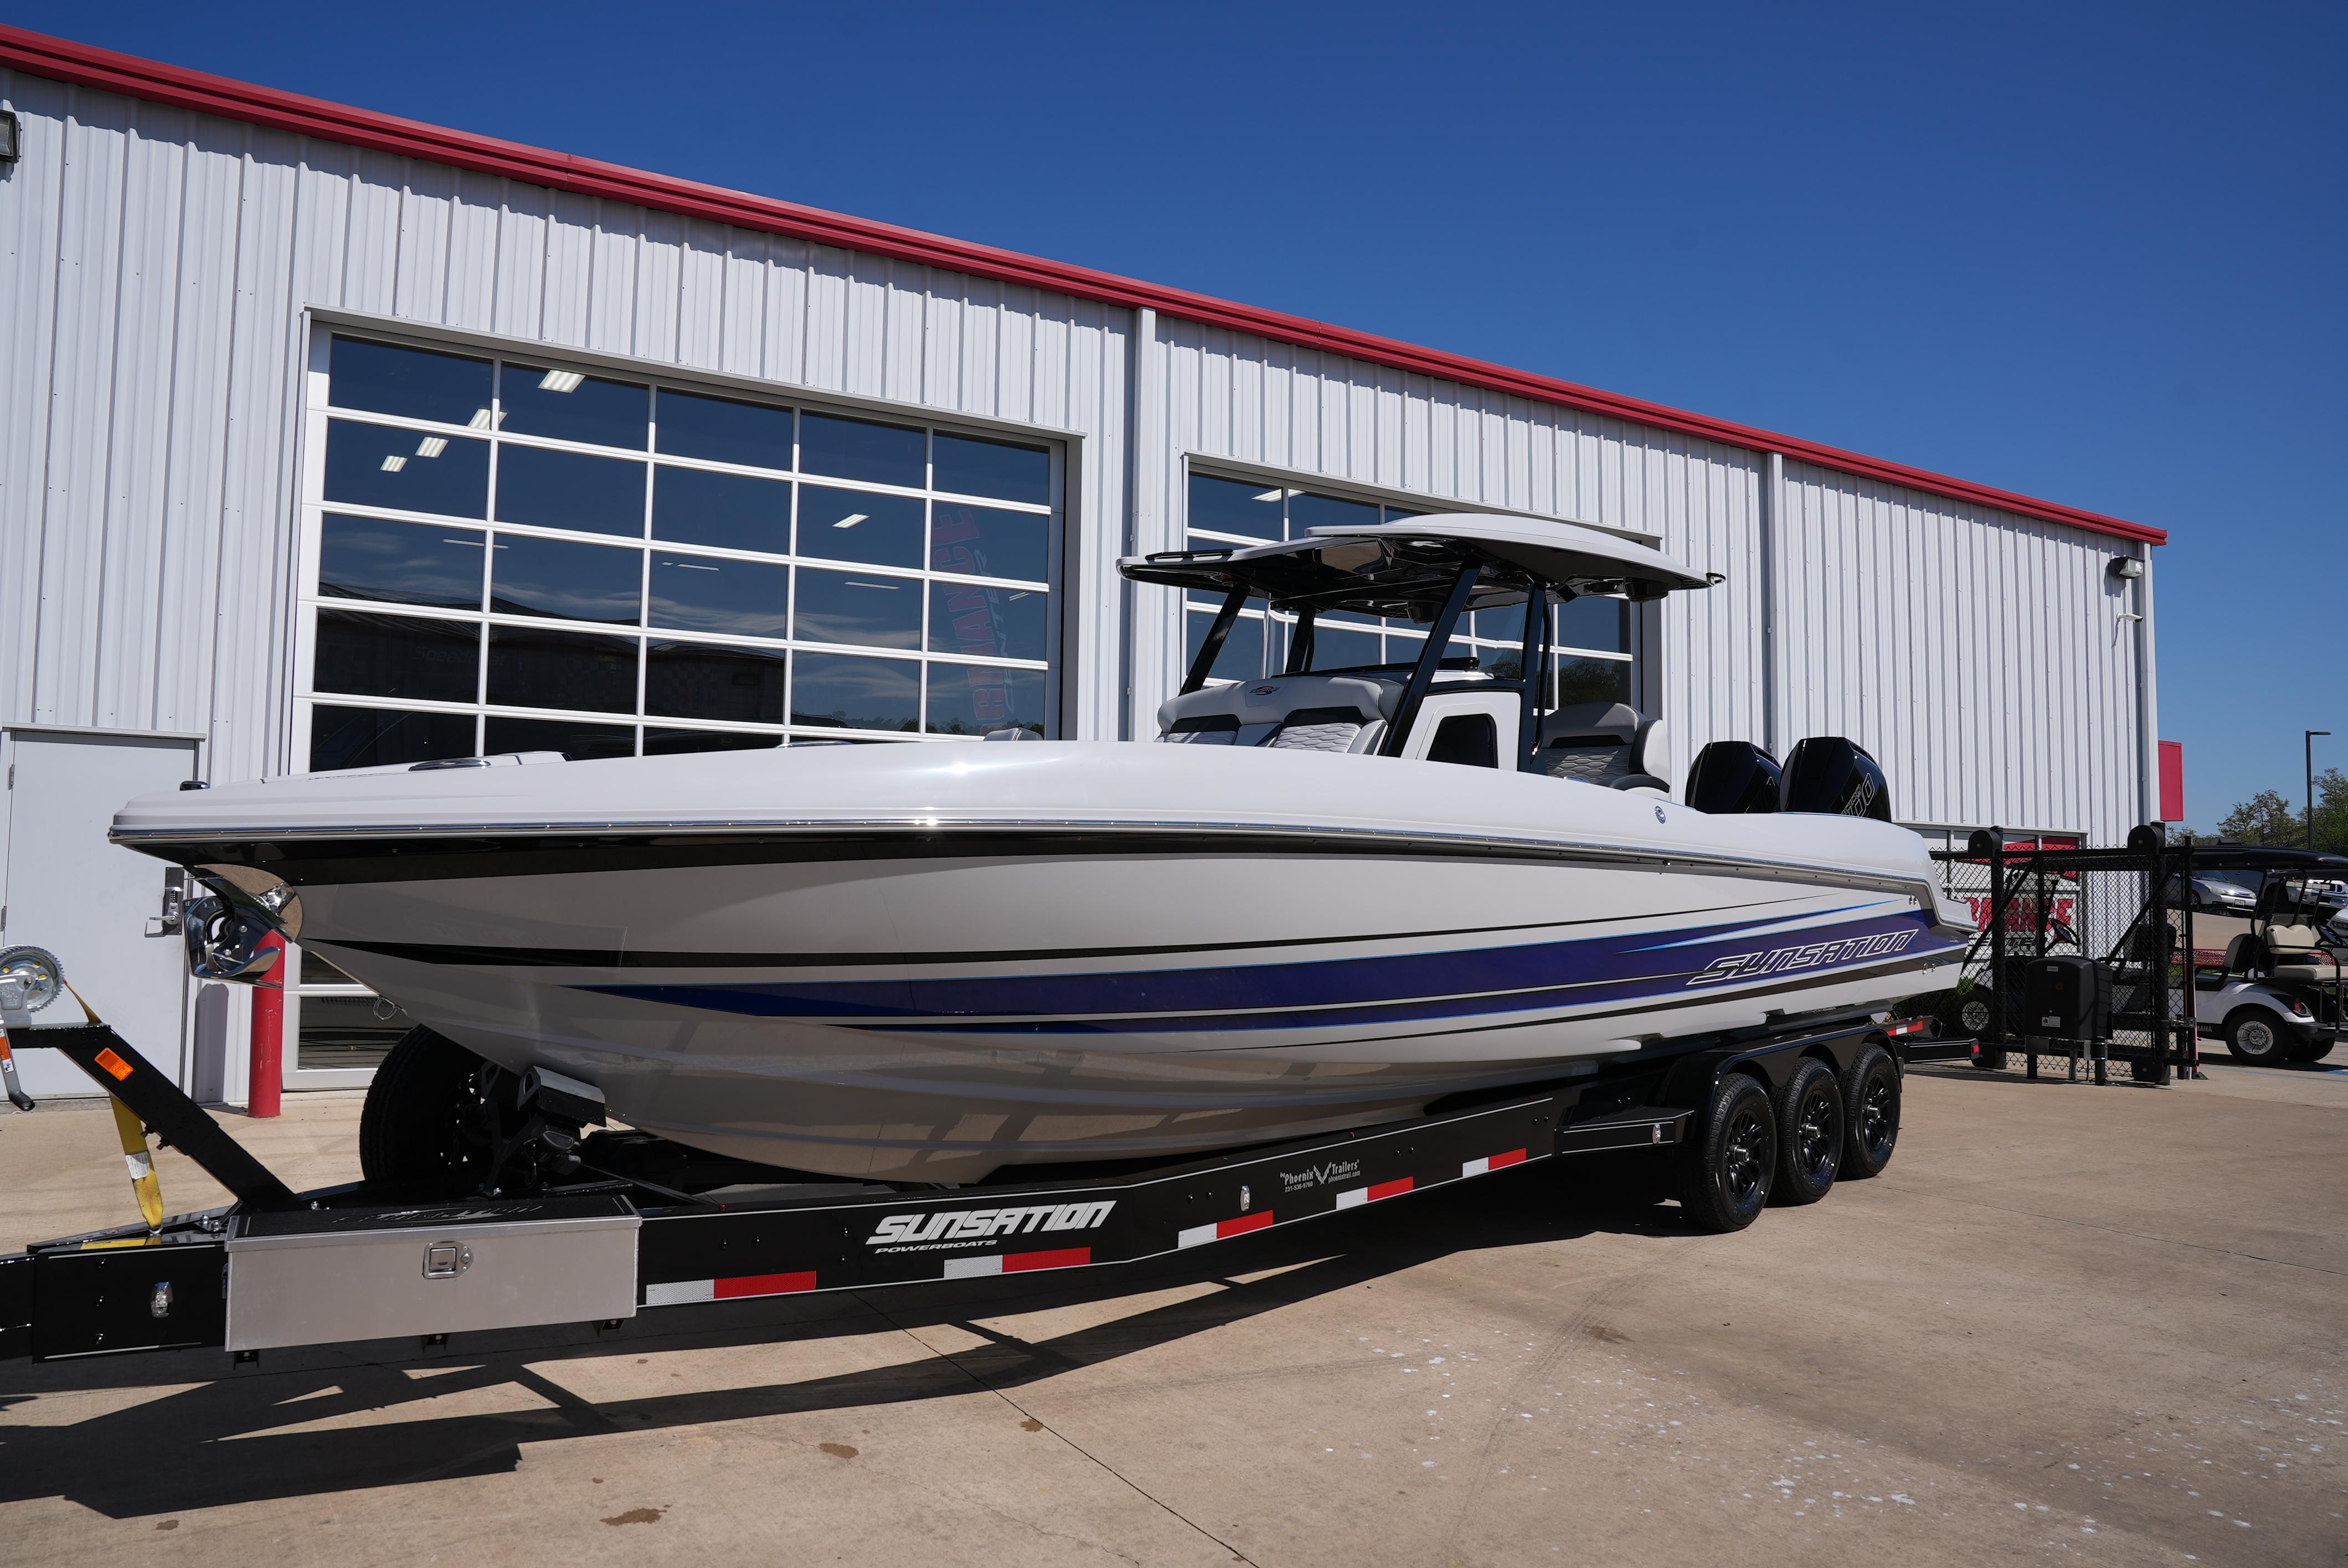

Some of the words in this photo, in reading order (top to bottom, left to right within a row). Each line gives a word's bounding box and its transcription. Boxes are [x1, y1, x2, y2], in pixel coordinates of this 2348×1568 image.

[411, 645, 506, 666] Speedbat
[1686, 929, 1919, 986] SUNSATION
[1285, 1169, 1314, 1185] Phoenix
[1328, 1170, 1361, 1184] phoenixtrail.com
[866, 1200, 1117, 1245] SUNSATION
[875, 1240, 997, 1254] POWERBOATS
